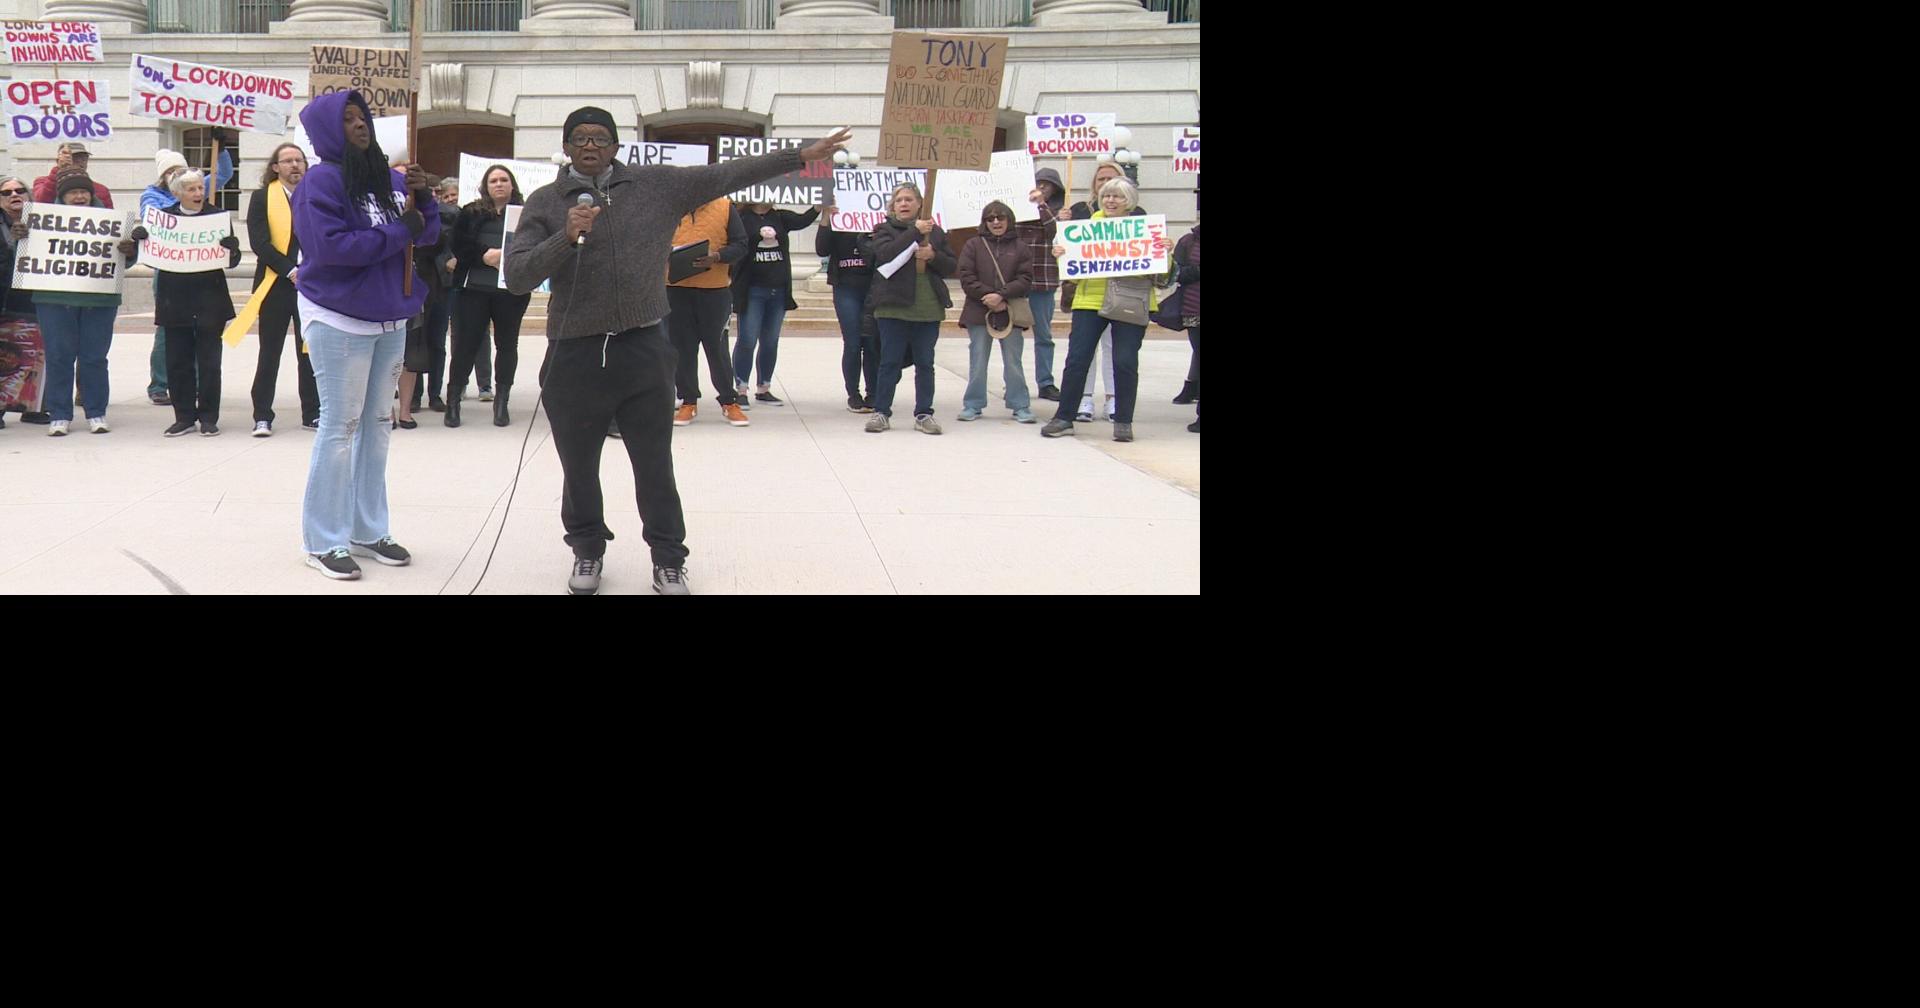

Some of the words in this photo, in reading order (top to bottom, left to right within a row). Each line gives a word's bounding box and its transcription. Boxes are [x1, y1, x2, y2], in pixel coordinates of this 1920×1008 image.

[6, 31, 60, 44] DOWNS
[67, 33, 98, 44] ARE
[11, 44, 96, 62] INHUMANE
[921, 39, 997, 68] TONY
[136, 56, 175, 90] LONG
[172, 63, 293, 100] LOCKDOWNS
[351, 76, 372, 87] ON
[7, 80, 97, 105] OPEN
[222, 94, 256, 108] ARE
[891, 80, 947, 108] NATIONAL
[952, 84, 997, 110] GUARD
[40, 105, 76, 116] THE
[140, 92, 256, 128] TORTURE
[12, 113, 110, 139] DOORS
[911, 124, 934, 135] WE
[942, 125, 973, 138] ARE
[1036, 114, 1087, 129] END
[1057, 126, 1099, 140] THIS
[883, 132, 939, 162] BETTER
[943, 136, 984, 152] THAN
[1028, 139, 1109, 155] LOCKDOWN
[943, 150, 981, 168] THIS
[969, 174, 995, 187] NOT
[25, 213, 122, 238] RELEASE
[146, 207, 178, 230] END
[149, 223, 226, 245] CRIMELESS
[1063, 218, 1146, 243] COMMUTE
[48, 238, 114, 259] THOSE
[143, 239, 226, 262] REVOCATIONS
[1080, 239, 1154, 260] UNJUST
[16, 256, 117, 279] ELIGIBLE!
[1066, 258, 1153, 276] SENTENCES
